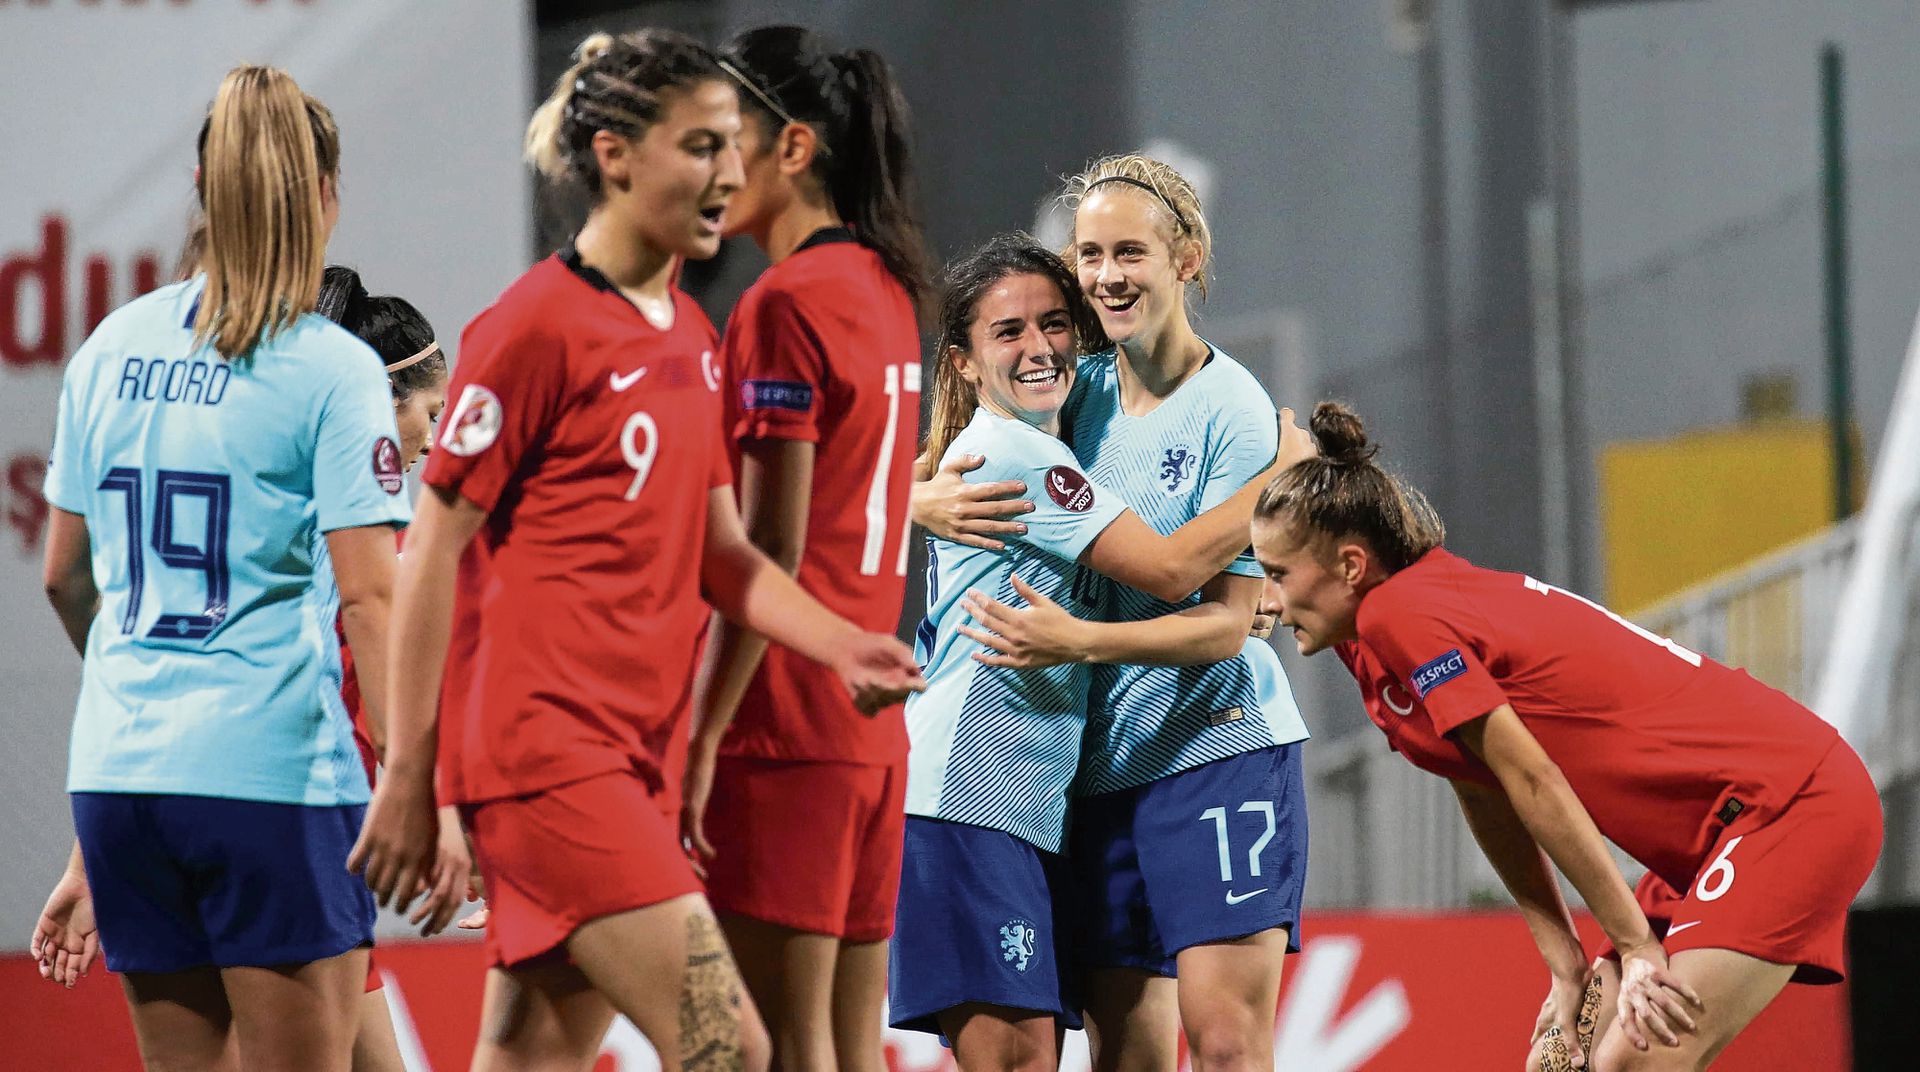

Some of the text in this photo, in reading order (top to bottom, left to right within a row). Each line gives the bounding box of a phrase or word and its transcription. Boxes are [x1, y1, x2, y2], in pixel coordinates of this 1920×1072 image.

[118, 357, 231, 406] ROORD
[619, 410, 659, 502] 9
[1065, 482, 1089, 510] CHAMPIONS
[1075, 491, 1091, 511] 2017
[99, 466, 231, 639] 19
[1417, 654, 1463, 689] RESPECT
[1198, 800, 1277, 882] 17
